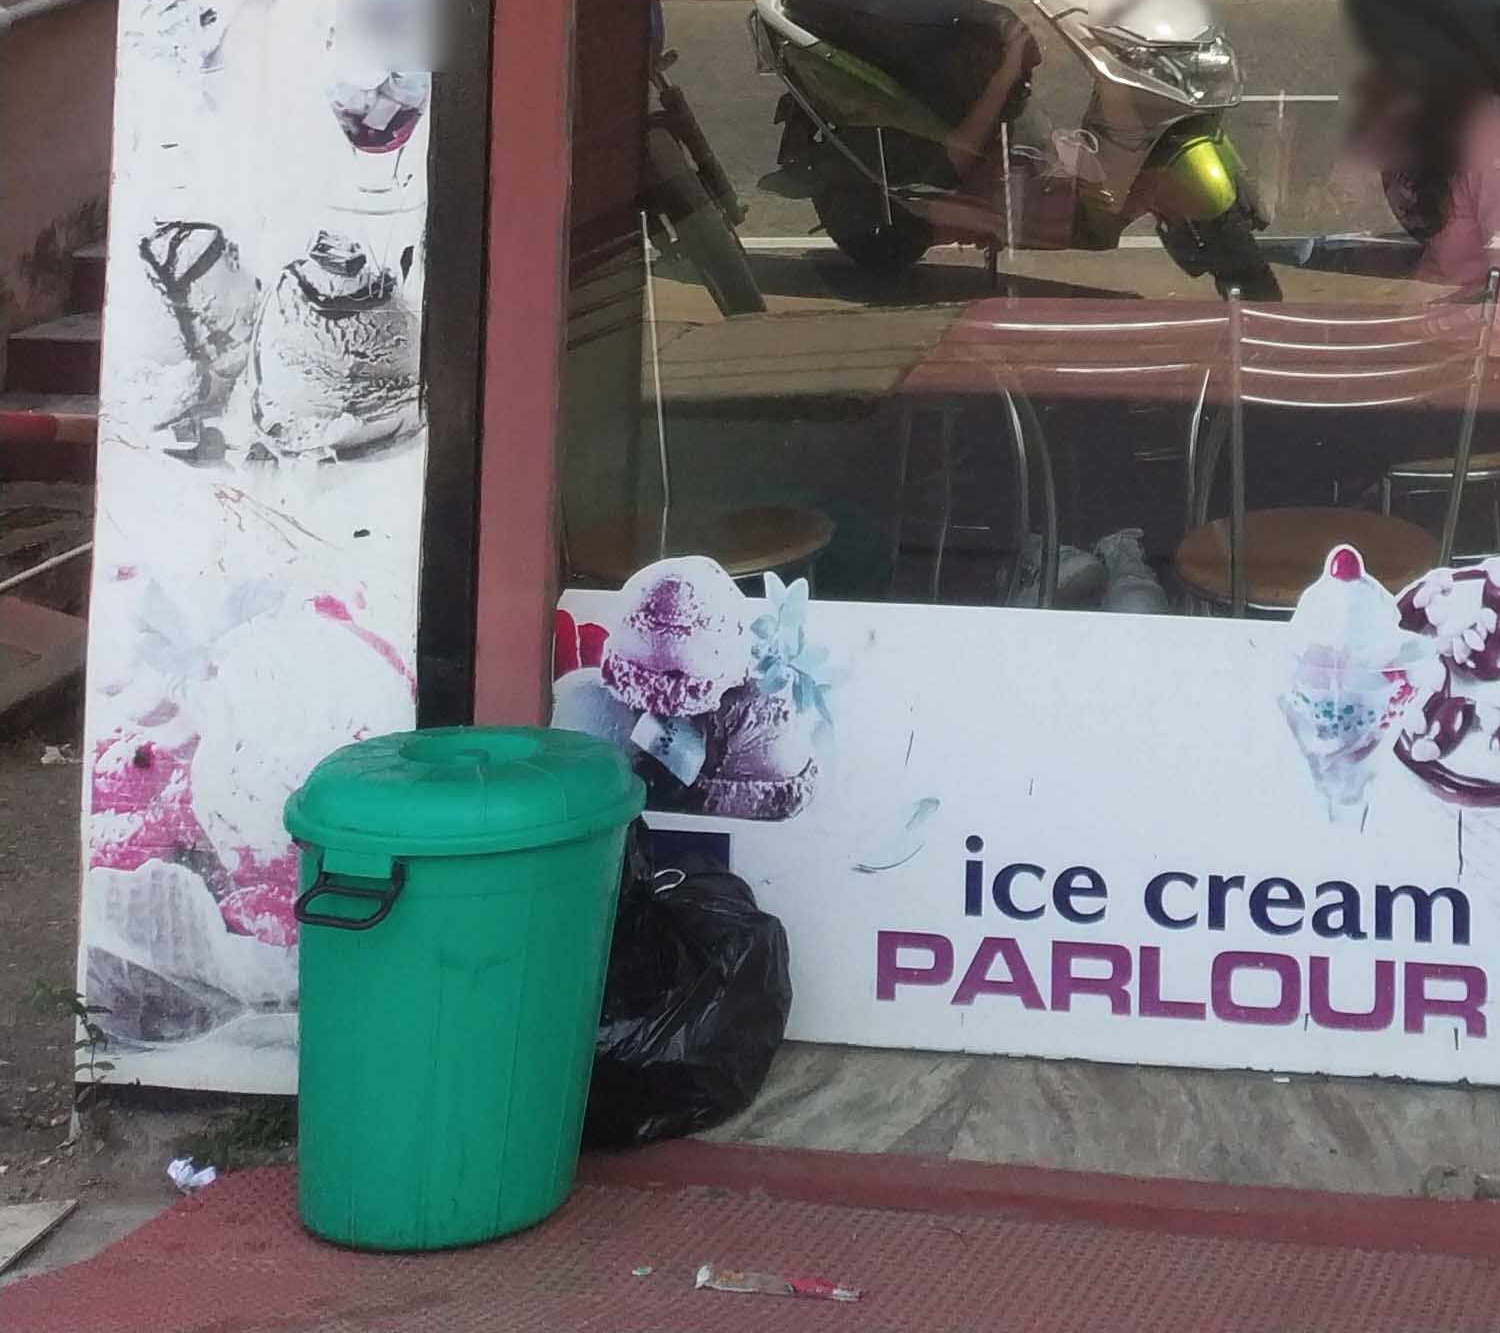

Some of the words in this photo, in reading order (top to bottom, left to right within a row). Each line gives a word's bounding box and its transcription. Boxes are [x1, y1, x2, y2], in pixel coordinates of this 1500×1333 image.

[965, 835, 1108, 924] ice
[1144, 871, 1471, 946] cream
[876, 929, 1488, 1039] PARLOUR
